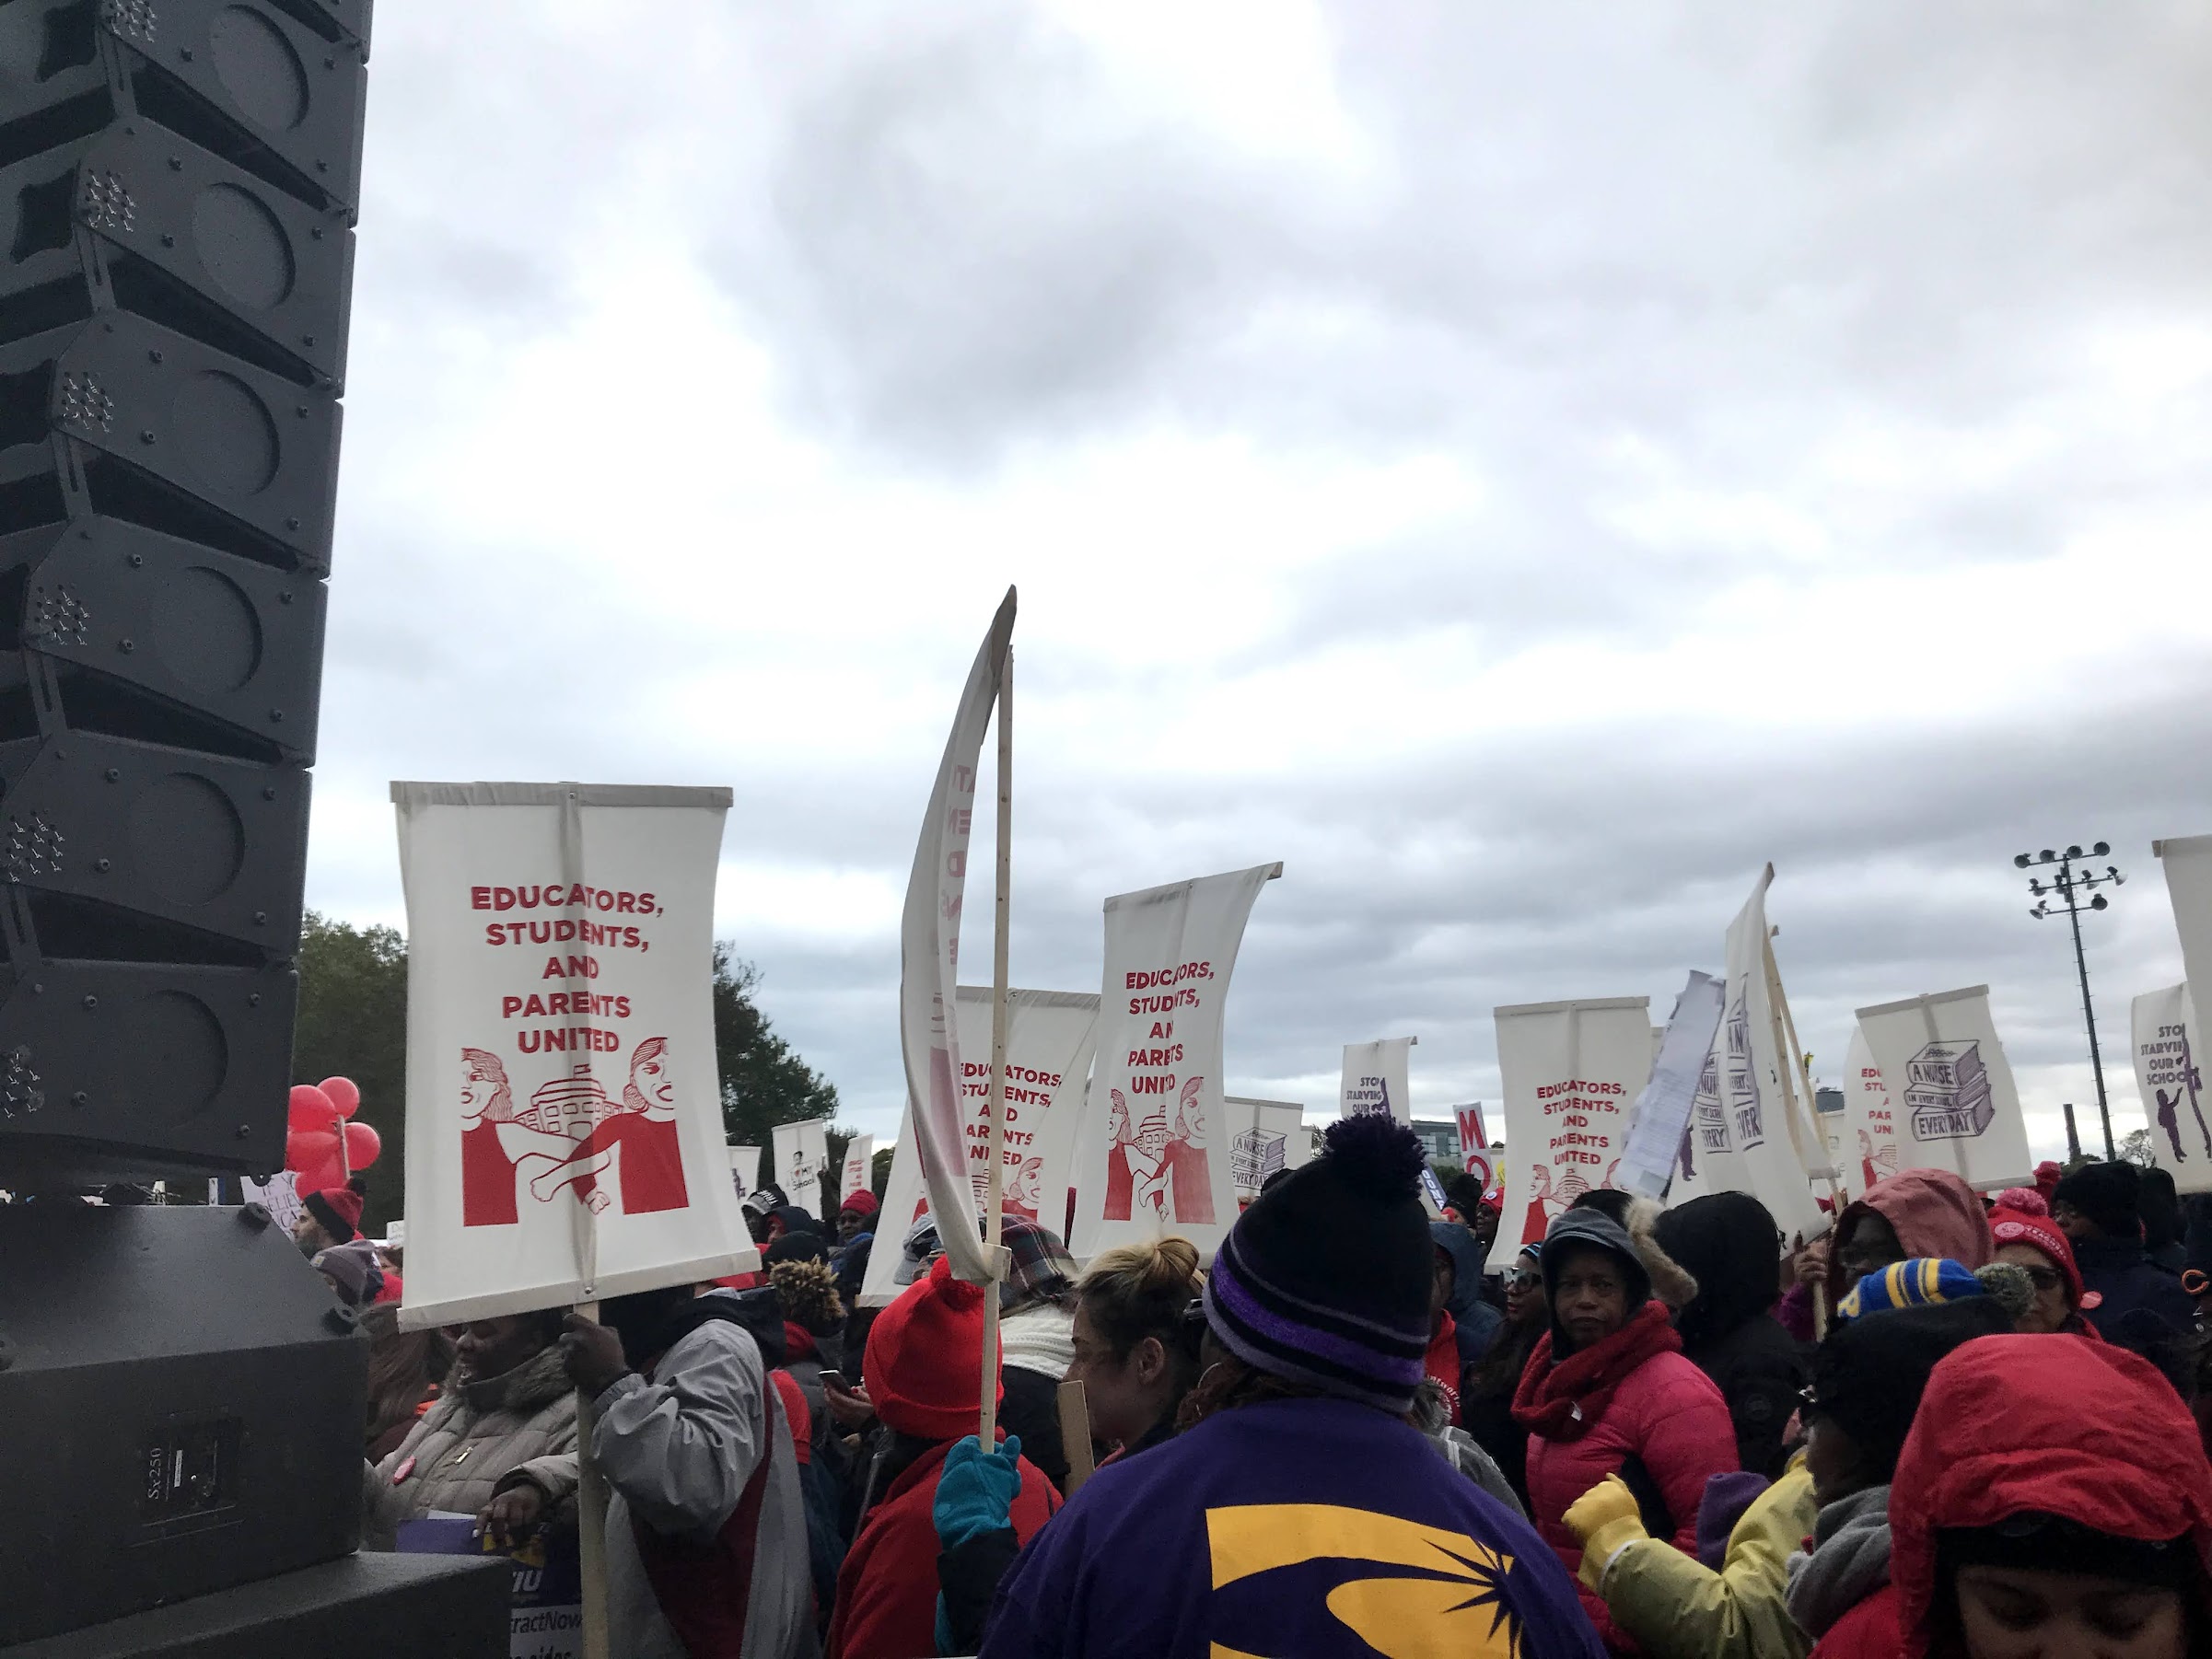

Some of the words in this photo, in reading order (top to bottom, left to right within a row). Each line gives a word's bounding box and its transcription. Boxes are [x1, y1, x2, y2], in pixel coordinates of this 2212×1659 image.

[471, 884, 664, 918] EDUCATORS,
[485, 919, 650, 953] STUDENTS,
[541, 955, 600, 980] AND
[502, 991, 632, 1018] PARENTS
[1129, 988, 1201, 1015] STUDNTS,
[518, 1027, 620, 1053] UNITED
[2159, 1025, 2182, 1038] STO
[1127, 1043, 1183, 1067] PARETS
[2148, 1057, 2174, 1070] OUR
[960, 1062, 1062, 1088] DUATORS,
[1360, 1076, 1380, 1086] STO
[1913, 1063, 1923, 1081] A
[961, 1083, 1052, 1108] STUENTS,
[1536, 1080, 1627, 1099] EDUCATORS,
[978, 1104, 1018, 1121] AD
[1352, 1104, 1370, 1114] OUR
[1543, 1097, 1620, 1115] STUDENTS,
[1562, 1115, 1589, 1128] AND
[1948, 1112, 1970, 1132] DAY
[966, 1124, 1034, 1145] ARNTS
[1550, 1132, 1610, 1149] PARENTS
[969, 1144, 1022, 1166] NIED
[1243, 1138, 1265, 1159] NURSE
[1554, 1150, 1601, 1166] UNITED
[147, 1447, 162, 1500] Sx250
